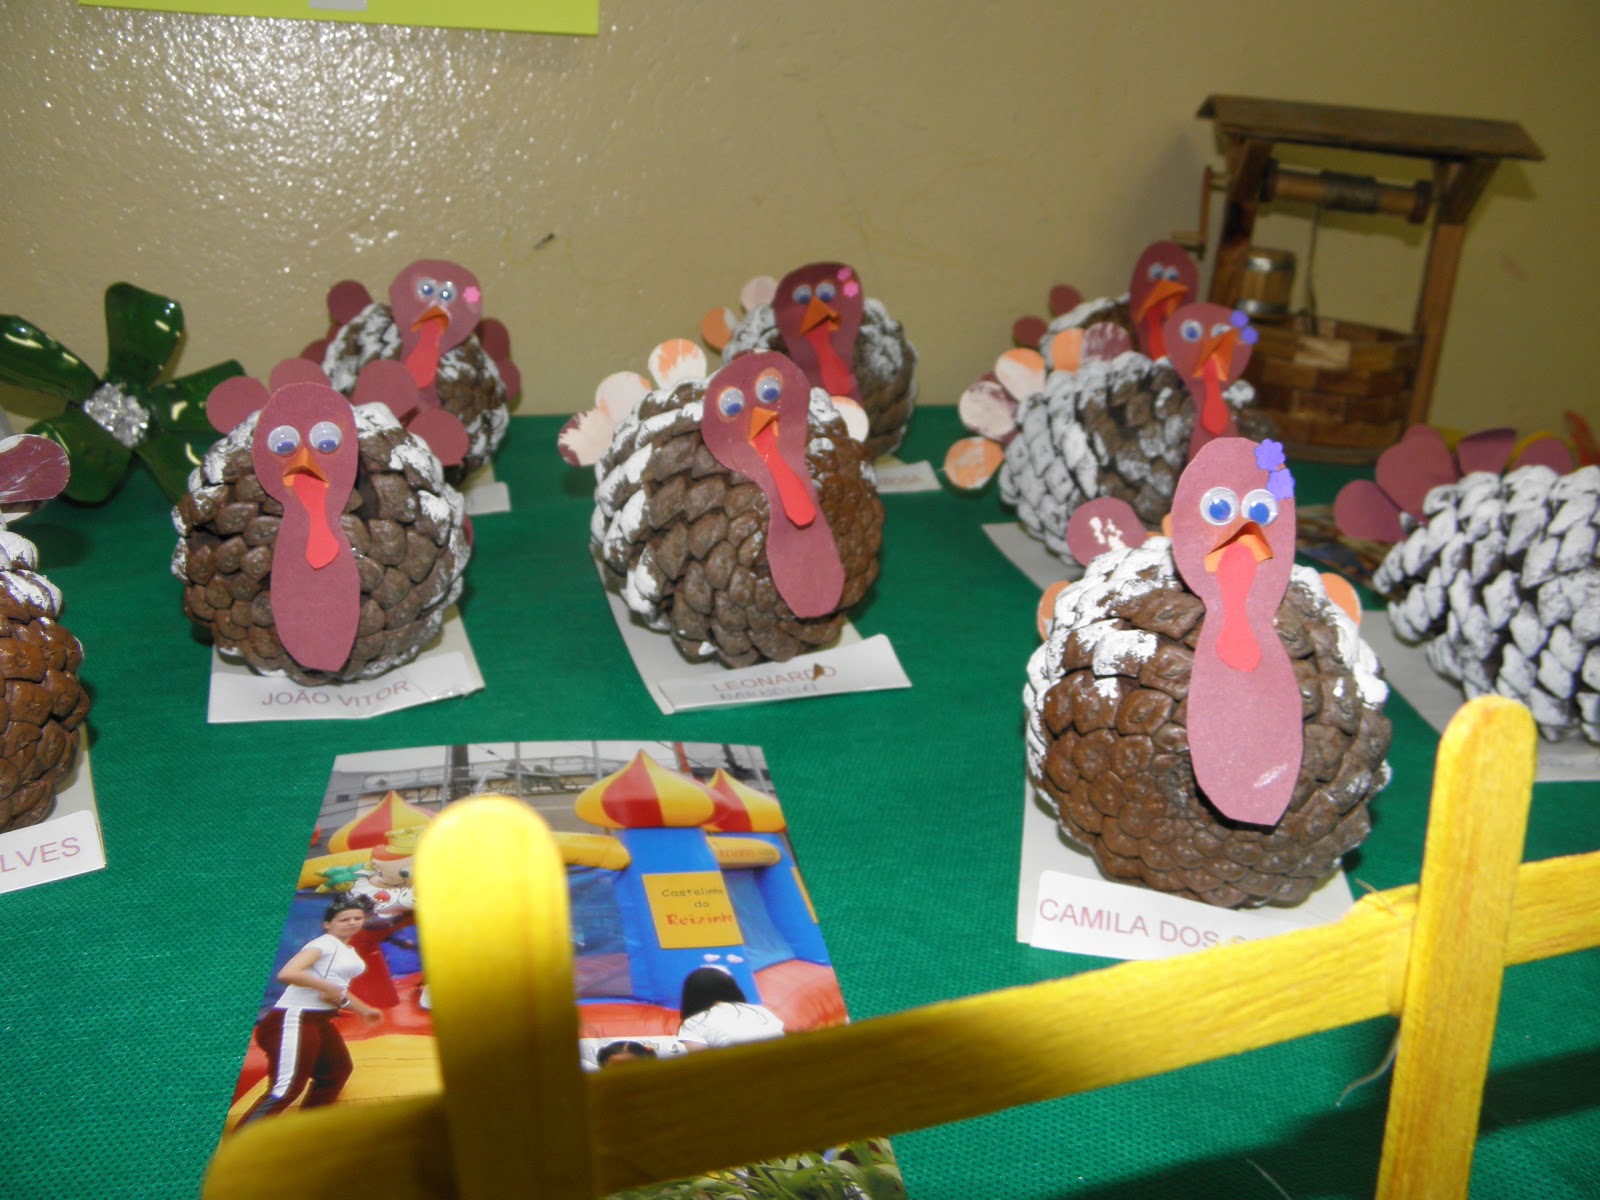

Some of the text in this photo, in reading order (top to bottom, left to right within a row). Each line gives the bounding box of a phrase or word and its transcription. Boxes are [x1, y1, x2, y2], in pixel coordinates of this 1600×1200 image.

[261, 680, 409, 707] JOÃO VITOR
[693, 899, 710, 909] do
[1039, 898, 1220, 948] CAMILA DOS
